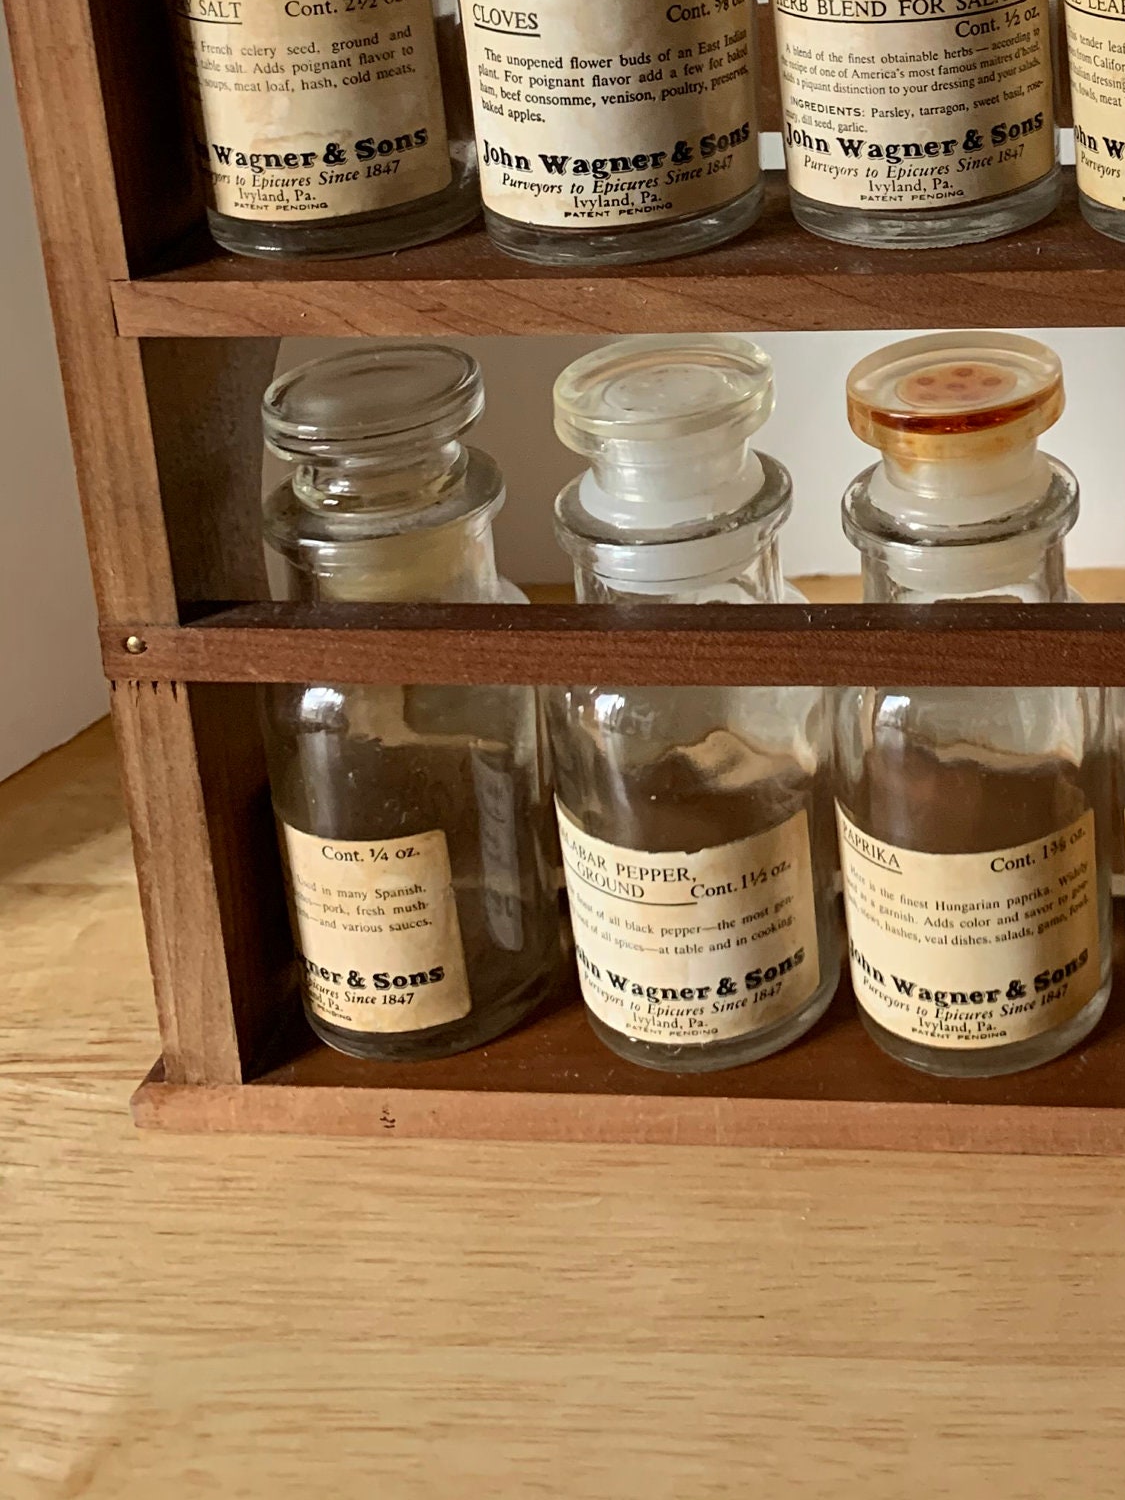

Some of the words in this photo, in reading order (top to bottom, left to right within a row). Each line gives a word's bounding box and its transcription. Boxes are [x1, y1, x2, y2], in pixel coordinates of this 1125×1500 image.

[200, 0, 242, 18] SALT
[285, 0, 337, 18] Cont.
[472, 3, 539, 30] CLOVES
[666, 4, 711, 23] Cont.
[955, 16, 1000, 38] Cont.
[253, 61, 285, 74] Adds
[292, 58, 351, 75] poignant
[359, 49, 395, 66] flavor
[402, 45, 413, 56] to
[484, 48, 502, 62] The
[506, 54, 563, 70] unopened
[570, 57, 611, 69] flower
[620, 54, 651, 66] buds
[658, 50, 672, 62] of
[678, 48, 692, 59] an
[698, 40, 720, 55] East
[790, 95, 865, 117] INGREDIENTS:
[871, 106, 914, 119] Parsley,
[919, 101, 969, 117] tarragon,
[973, 93, 1000, 108] sweet
[1100, 93, 1122, 107] meat
[212, 144, 318, 173] Wagner
[323, 143, 347, 165] &
[354, 128, 429, 161] Sons
[483, 140, 531, 171] John
[539, 151, 666, 179] Wagner
[671, 141, 692, 164] &
[700, 122, 750, 158] Sons
[785, 122, 831, 153] John
[837, 136, 959, 164] Wagner
[962, 129, 983, 151] &
[991, 112, 1044, 146] Sons
[236, 173, 246, 186] to
[252, 174, 311, 189] Epicures
[319, 170, 360, 186] Since
[365, 160, 400, 178] 1847
[502, 173, 562, 196] Purveyors
[570, 182, 584, 194] to
[592, 176, 659, 196] Epicures
[666, 167, 701, 186] Since
[707, 155, 733, 174] 1847
[869, 179, 927, 195] Ivyland,
[932, 178, 953, 190] Pa.
[238, 187, 289, 203] Ivyland,
[295, 189, 316, 201] Pa.
[574, 193, 634, 210] Ivyland,
[641, 190, 661, 202] Pa.
[564, 210, 610, 218] PATENT
[618, 202, 672, 216] PENDING
[321, 846, 365, 863] Cont.
[395, 847, 421, 859] oz.
[843, 823, 901, 869] PAPRIKA
[616, 864, 696, 882] PEPPER,
[990, 854, 1035, 873] Cont.
[577, 861, 644, 898] GROUND
[691, 882, 737, 898] Cont.
[771, 861, 791, 876] oz.
[900, 895, 928, 909] finest
[935, 900, 1000, 913] Hungarian
[342, 922, 383, 933] various
[347, 971, 366, 988] &
[373, 965, 445, 990] Sons
[606, 971, 711, 1003] Wagner
[717, 977, 736, 996] &
[745, 947, 805, 990] Sons
[850, 938, 886, 986] John
[891, 974, 1001, 1008] Wagner
[1005, 979, 1027, 1000] &
[1034, 948, 1089, 993] Sons
[344, 992, 377, 1005] Since
[382, 993, 414, 1005] 1847
[647, 1004, 704, 1016] Epicures
[711, 999, 748, 1014] Since
[753, 982, 783, 1003] 1847
